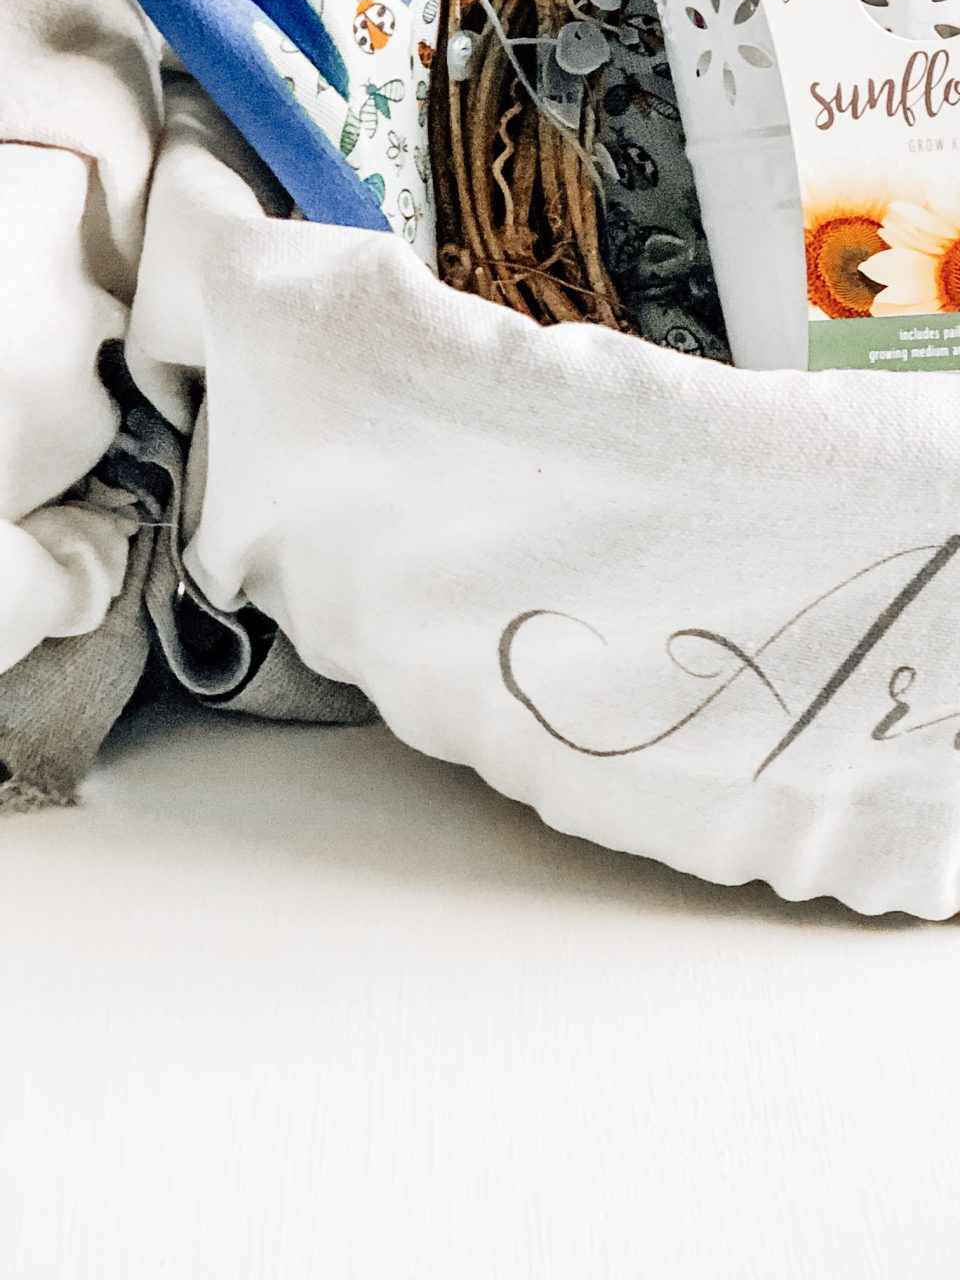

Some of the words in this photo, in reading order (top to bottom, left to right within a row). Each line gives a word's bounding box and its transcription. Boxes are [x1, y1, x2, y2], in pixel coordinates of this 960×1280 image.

[908, 138, 946, 153] GROW
[899, 326, 940, 341] includes
[868, 349, 909, 364] growing
[911, 344, 950, 358] medium
